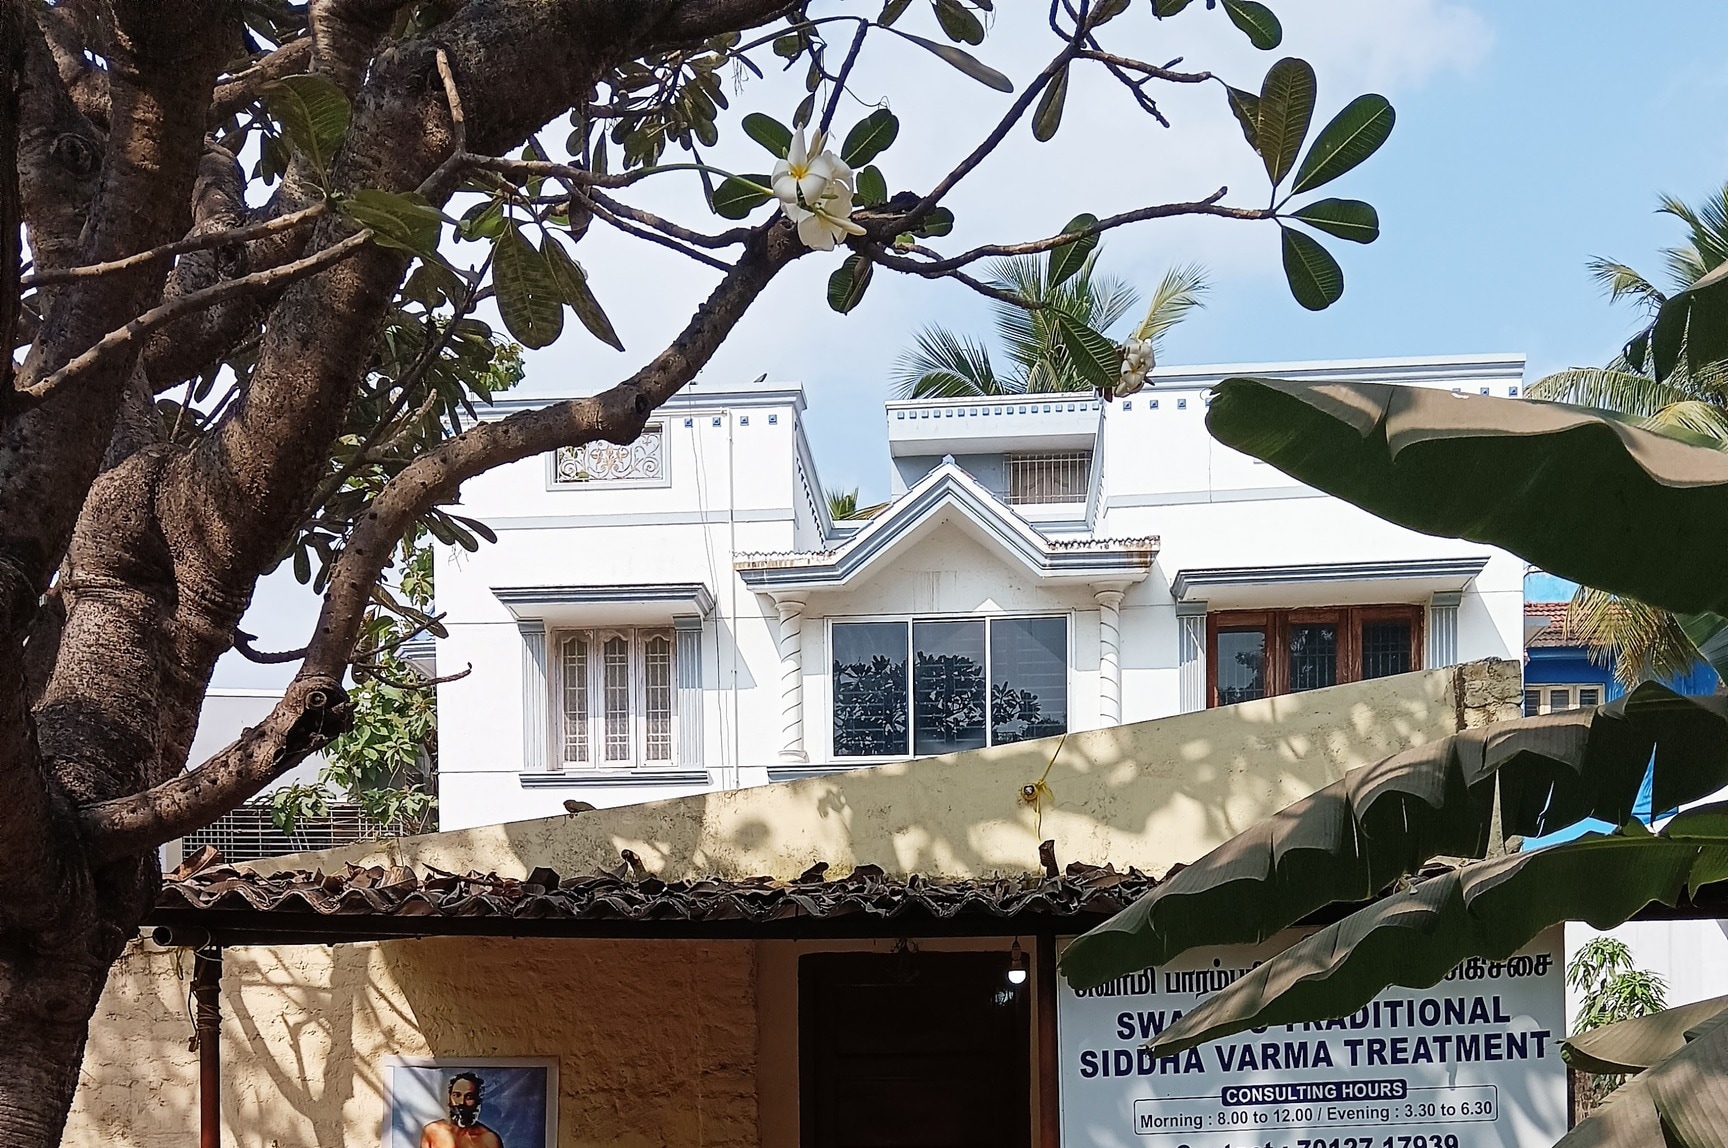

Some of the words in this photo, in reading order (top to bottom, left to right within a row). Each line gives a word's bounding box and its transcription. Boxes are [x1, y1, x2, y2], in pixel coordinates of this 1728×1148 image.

[1286, 997, 1511, 1033] DITIONAL
[1080, 1046, 1206, 1079] SIDDHA
[1215, 1040, 1334, 1072] VARMA
[1344, 1030, 1551, 1067] TREATMENT
[1226, 1084, 1336, 1103] CONSULTING
[1342, 1082, 1403, 1099] HOURS
[1140, 1113, 1203, 1129] Morning
[1217, 1111, 1249, 1125] 8.00
[1253, 1111, 1268, 1124] to
[1273, 1108, 1313, 1123] 12.00
[1327, 1106, 1390, 1122] Evening
[1404, 1103, 1436, 1118] 3.30
[1440, 1102, 1456, 1116] to
[1460, 1101, 1492, 1116] 6.30
